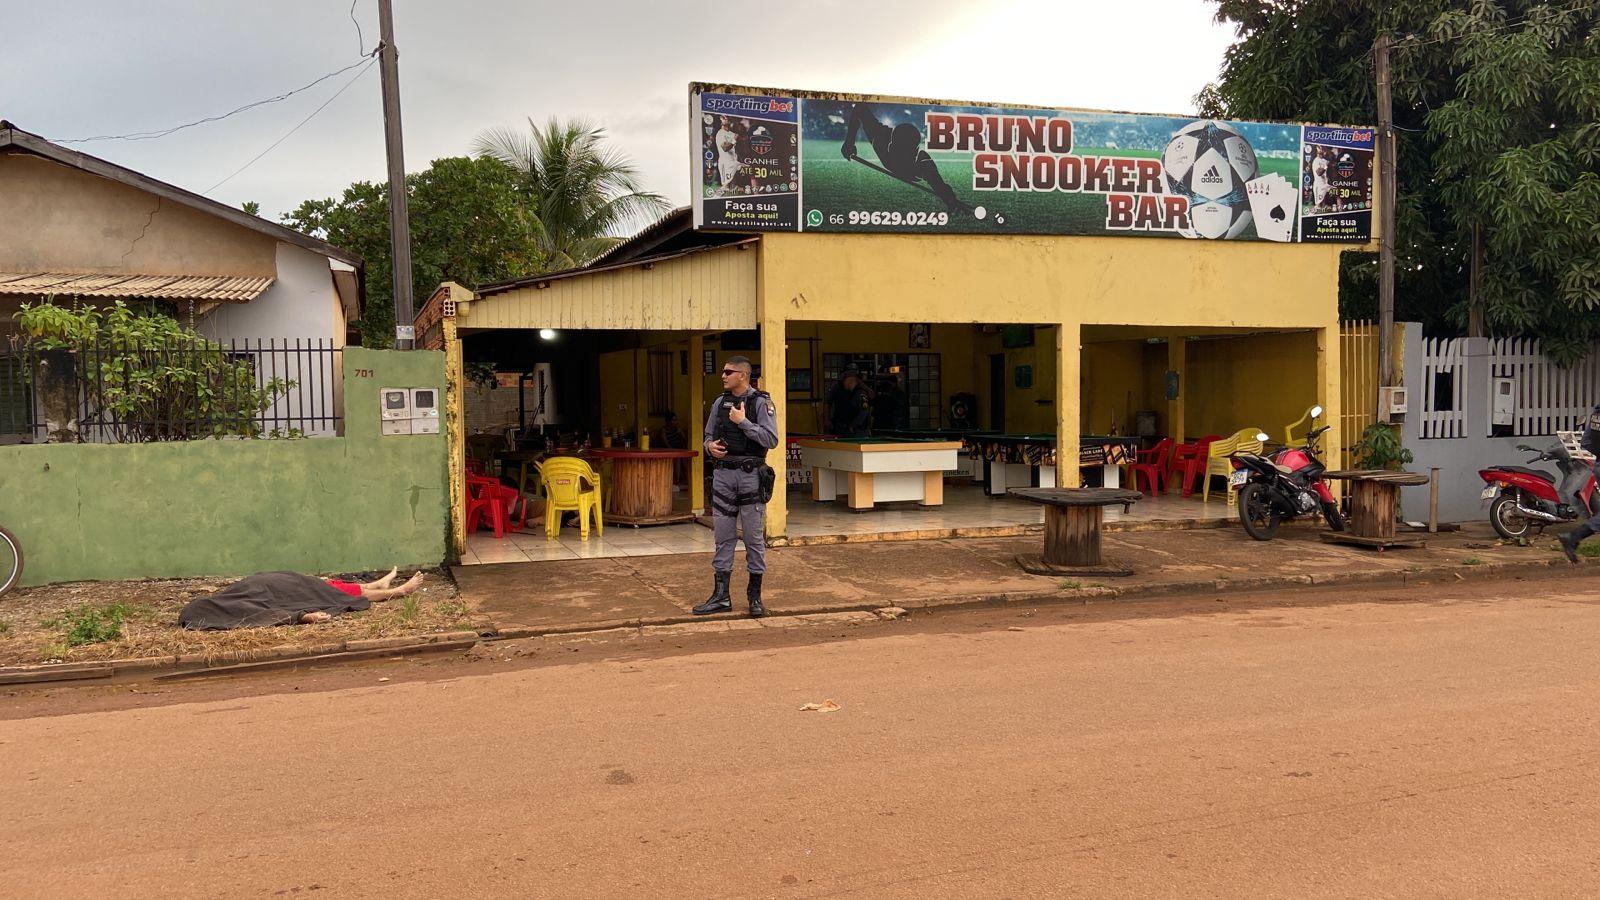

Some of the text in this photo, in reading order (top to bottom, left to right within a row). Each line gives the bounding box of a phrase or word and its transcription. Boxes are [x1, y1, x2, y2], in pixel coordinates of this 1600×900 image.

[926, 112, 1073, 154] BRUNO
[744, 157, 779, 166] GANHE
[754, 167, 768, 178] 30
[769, 169, 783, 177] MIL
[974, 154, 1162, 193] SNOOKER
[1340, 188, 1350, 199] 30
[725, 201, 778, 212] Faça sua
[725, 211, 755, 219] Aposta
[1107, 195, 1190, 230] BAR
[829, 211, 949, 226] 66 99629.0249
[1317, 217, 1338, 228] Faça
[354, 369, 374, 378] 701
